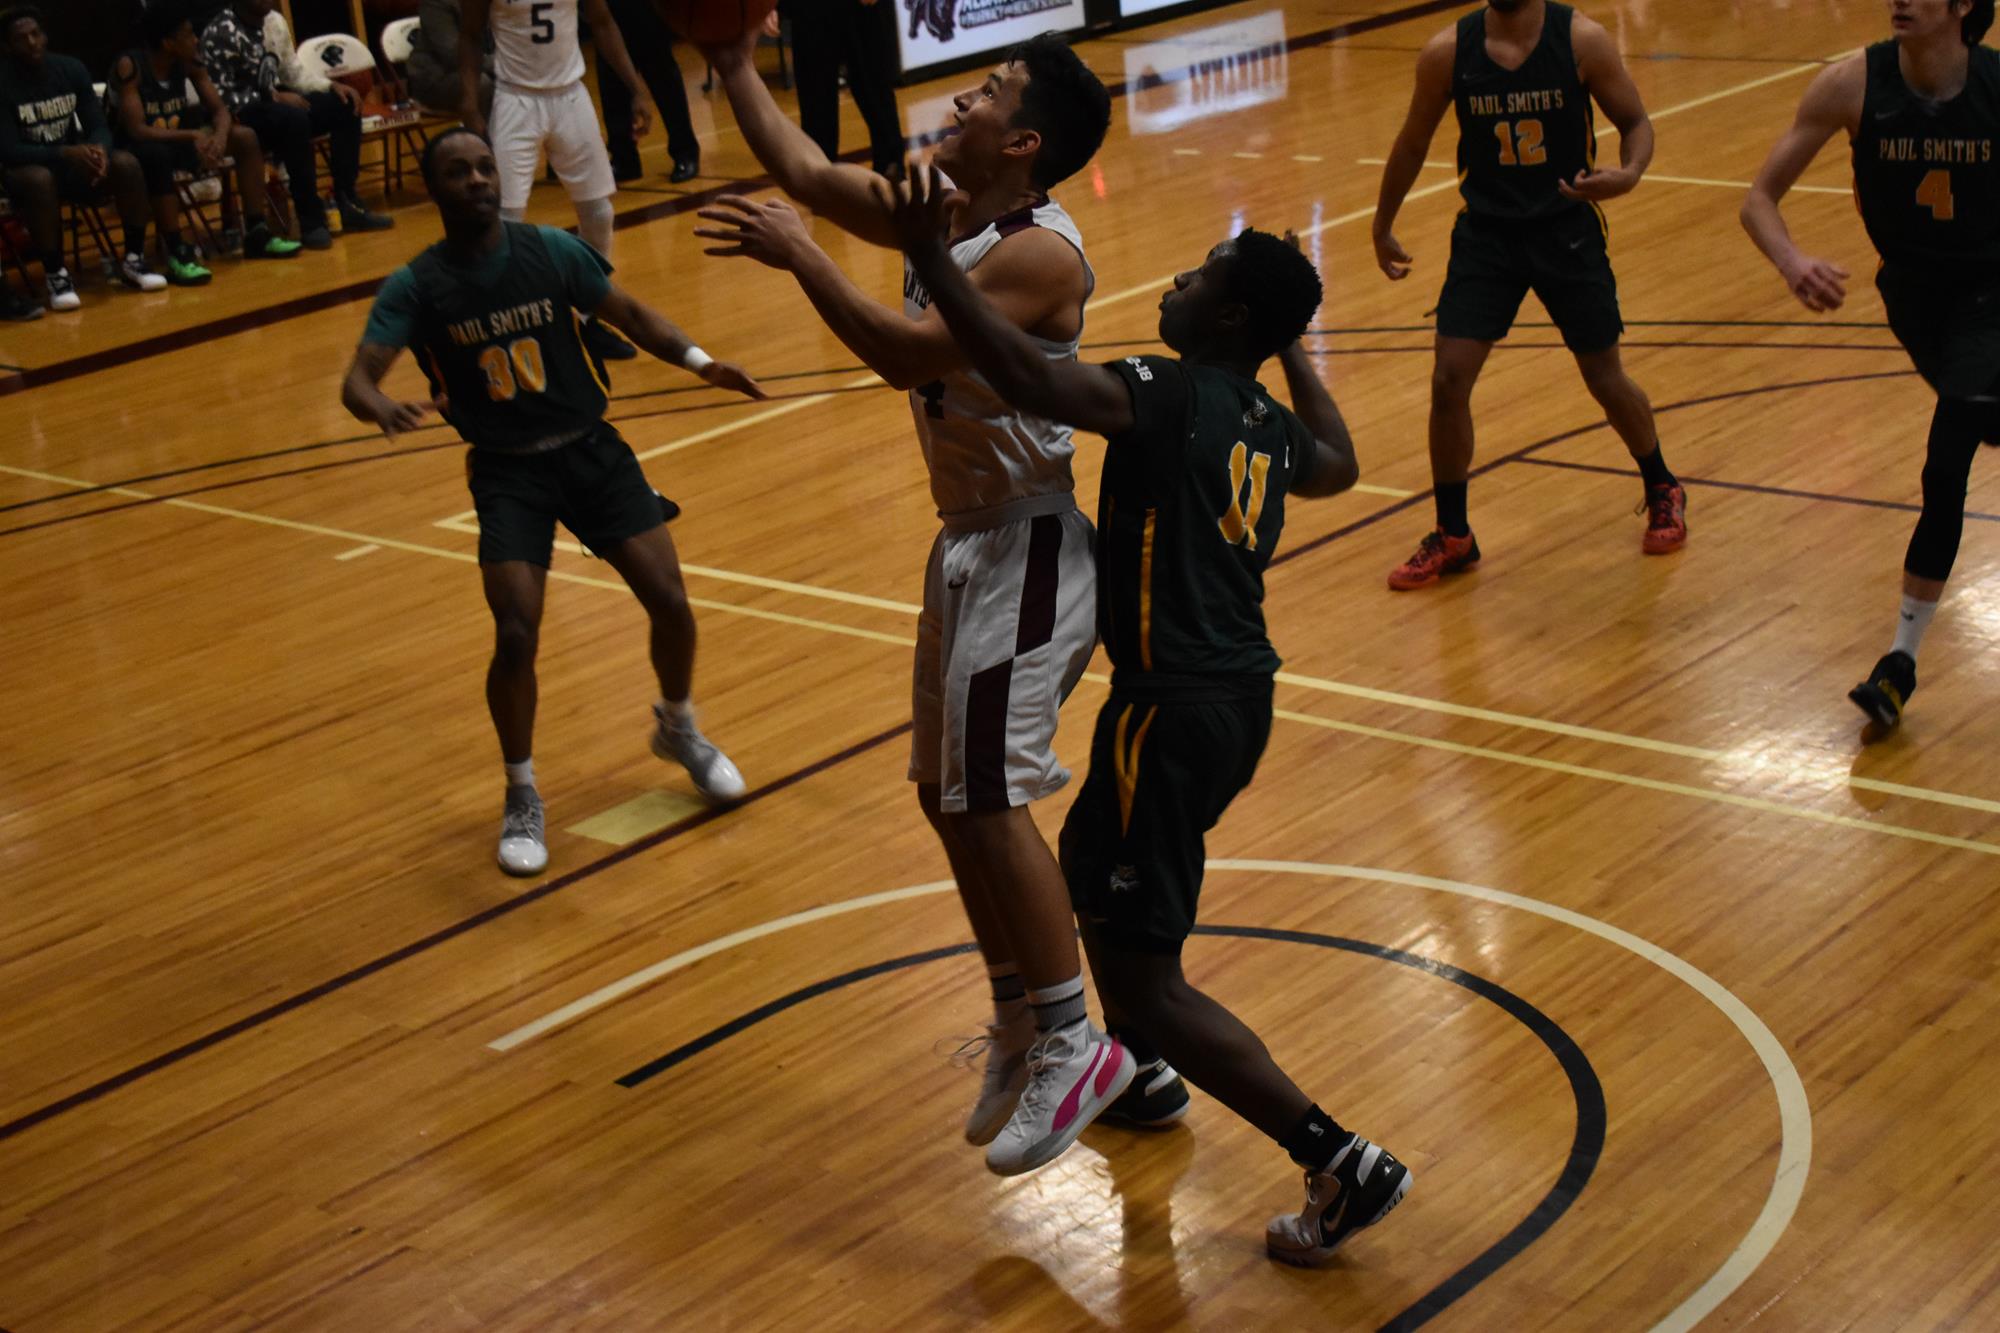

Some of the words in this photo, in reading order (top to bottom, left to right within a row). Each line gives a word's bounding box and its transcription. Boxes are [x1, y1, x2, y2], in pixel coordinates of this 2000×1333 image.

[531, 3, 554, 44] 5
[1468, 94, 1504, 116] PAUL
[1506, 88, 1565, 114] SMITH'S
[1493, 118, 1548, 167] 12
[1879, 137, 1918, 161] PAUL
[1922, 137, 1991, 164] SMITH'S
[1915, 169, 1955, 222] 4
[448, 317, 490, 345] PAUL
[489, 297, 554, 336] SMITH'S
[477, 335, 548, 402] 30
[1218, 440, 1271, 552] 11
